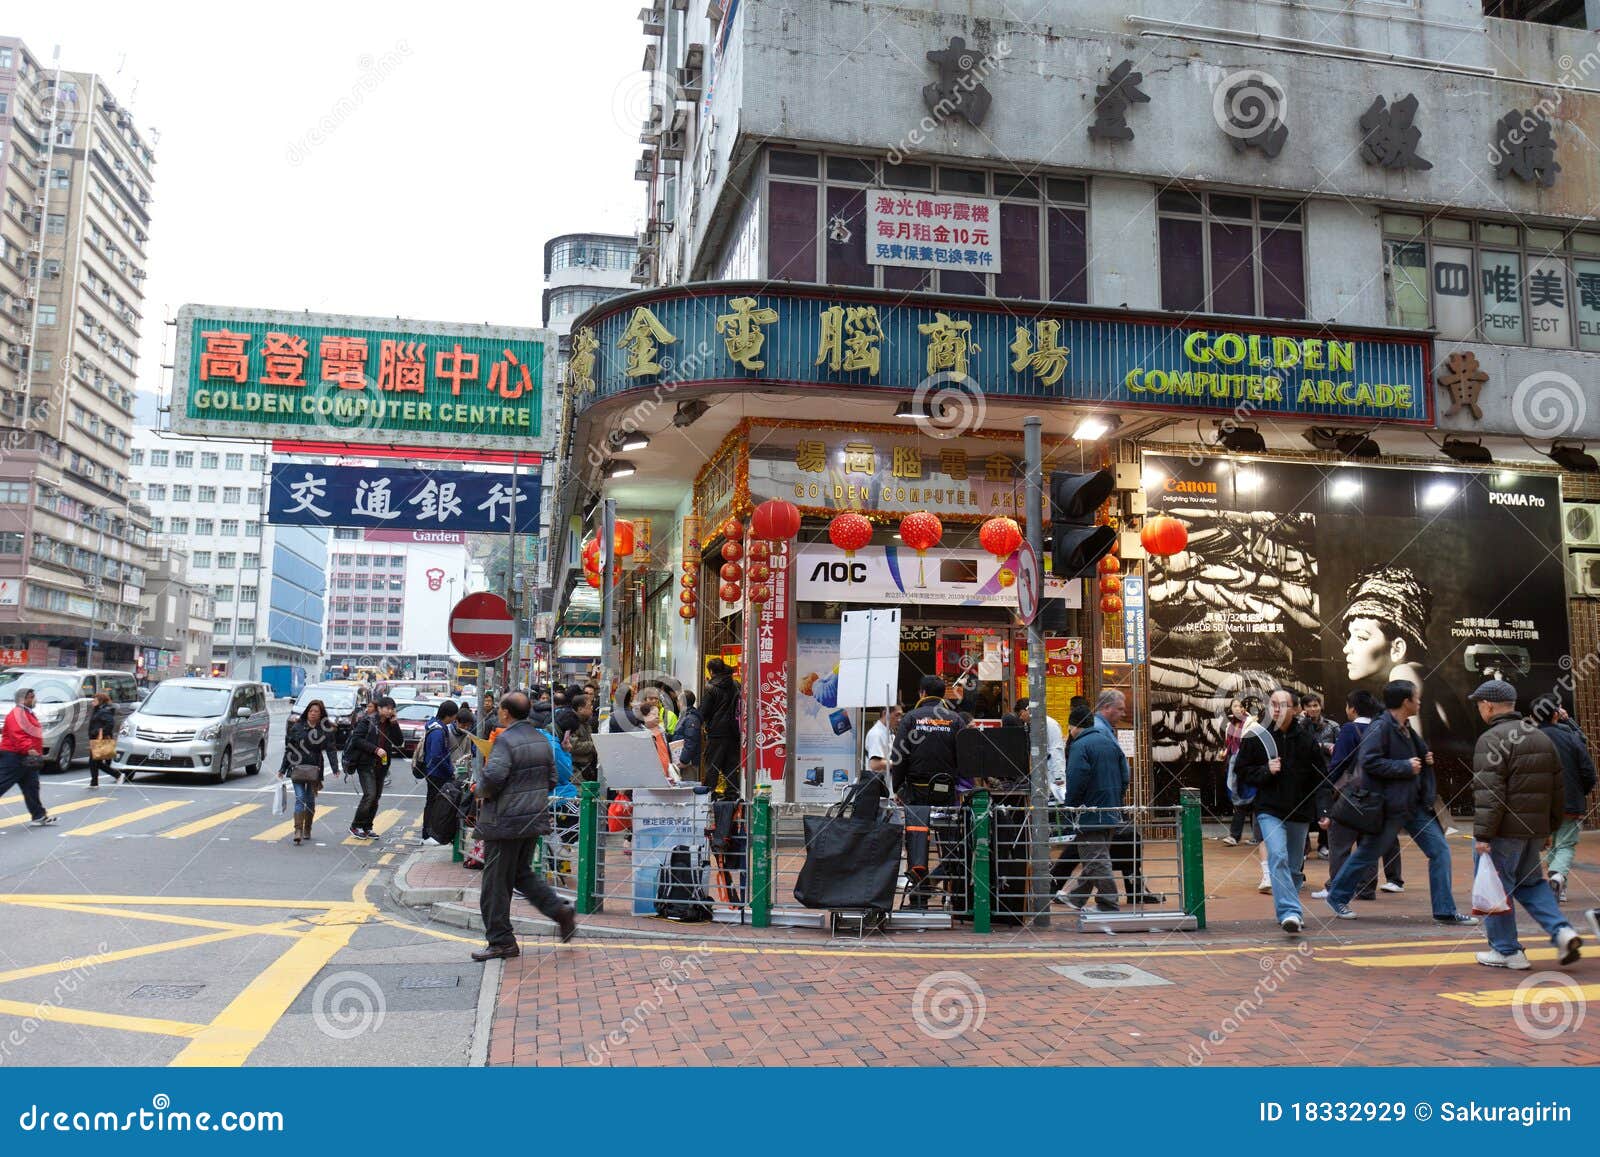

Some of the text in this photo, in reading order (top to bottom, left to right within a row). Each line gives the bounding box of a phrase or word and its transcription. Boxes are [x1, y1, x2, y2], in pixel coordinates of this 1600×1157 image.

[876, 220, 990, 246] 每月租金10元
[1184, 331, 1356, 372] GOLDEN
[199, 329, 533, 399] 高登電腦中心
[1125, 368, 1413, 409] COMPUTER ARCADE
[194, 389, 531, 426] GOLDEN COMPUTER CENTRE
[795, 484, 870, 500] GOLDEN
[883, 487, 978, 506] COMPUTER
[1163, 478, 1217, 493] Canon
[283, 473, 527, 524] 交通銀行
[1489, 492, 1545, 507] PIXMA Pro
[413, 530, 460, 544] Garden
[810, 562, 866, 582] AOC
[1226, 624, 1244, 632] Mark
